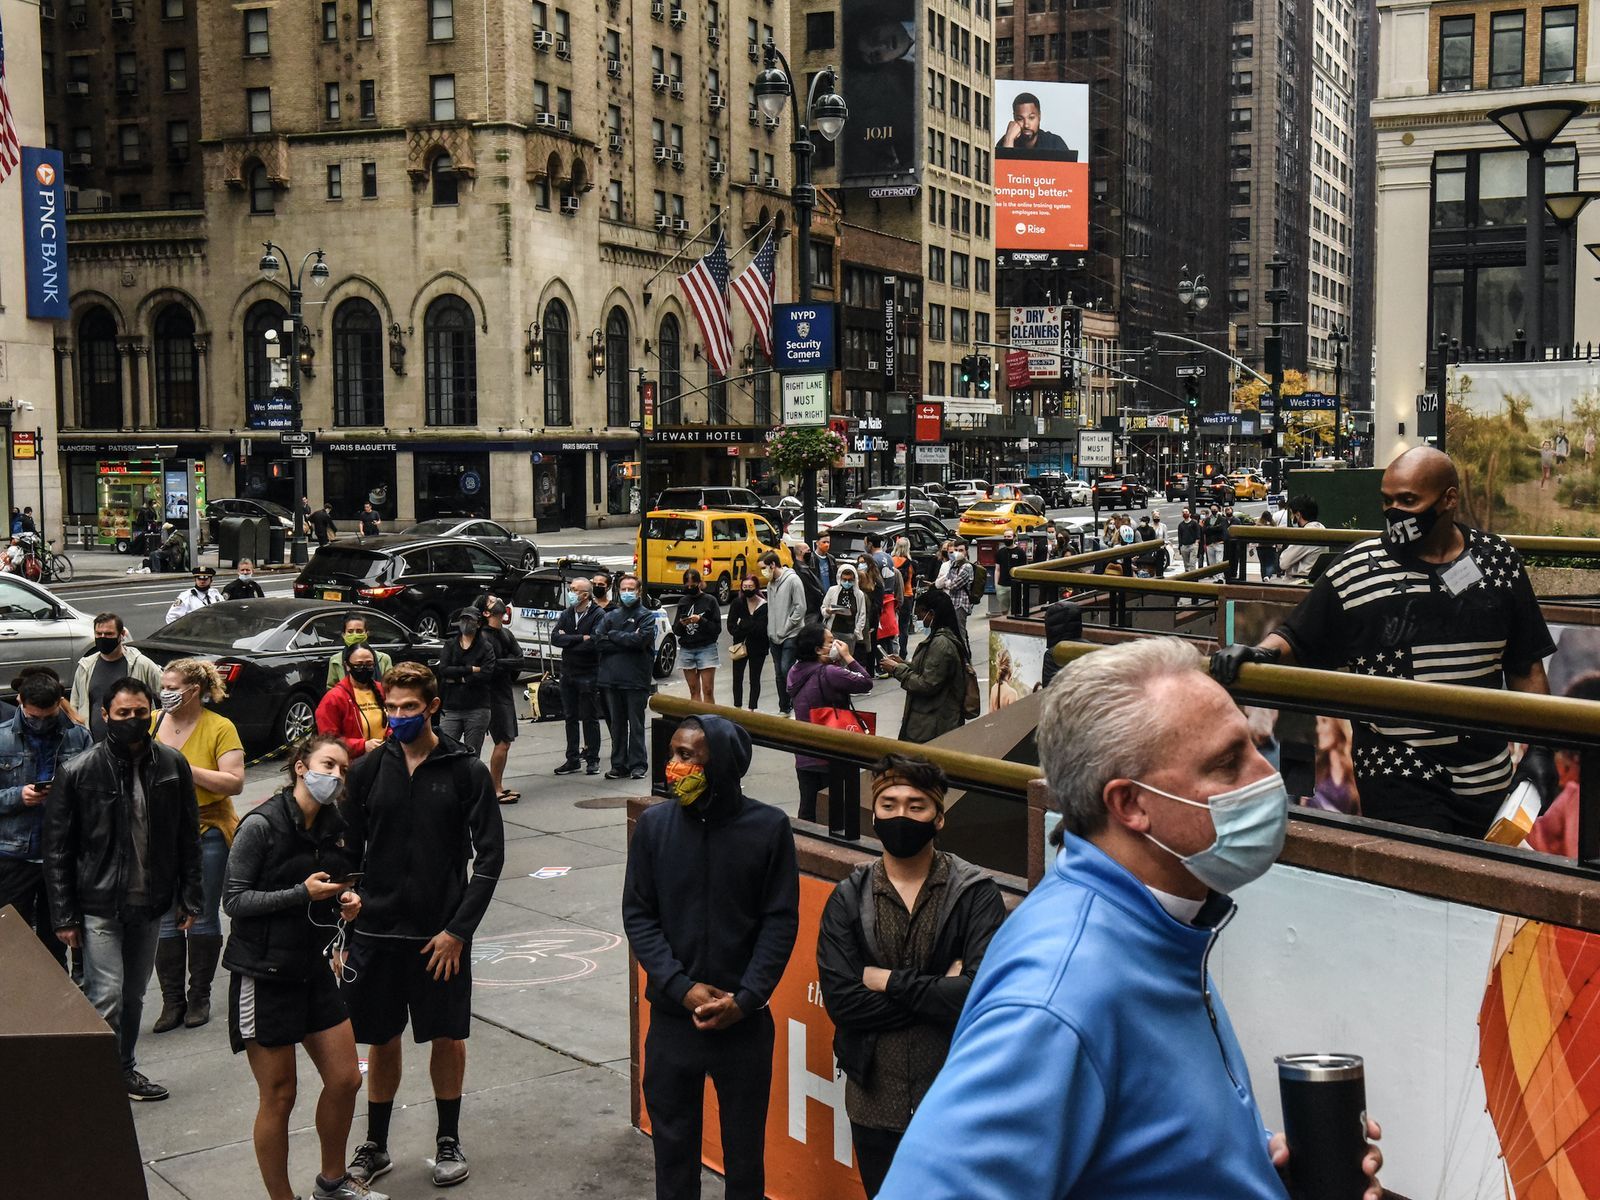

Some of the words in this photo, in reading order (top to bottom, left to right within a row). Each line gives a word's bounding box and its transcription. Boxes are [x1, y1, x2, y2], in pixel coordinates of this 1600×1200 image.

[864, 126, 892, 140] JOJI
[1007, 174, 1031, 184] Train
[1034, 178, 1056, 187] your
[871, 188, 915, 197] OUTFRONT
[39, 189, 56, 240] PNC
[1028, 224, 1046, 234] Rise
[41, 242, 59, 304] BANK
[791, 310, 816, 320] NYPD
[1026, 310, 1044, 324] DRY
[1012, 325, 1059, 339] CLEANERS
[786, 340, 822, 350] Security
[787, 350, 821, 359] Camera
[786, 382, 804, 390] RIGHT
[806, 381, 822, 389] LANE
[794, 395, 814, 406] MUST
[1327, 398, 1336, 407] St
[786, 412, 802, 420] TURN
[805, 411, 823, 419] RIGHT
[868, 417, 882, 429] Nails
[706, 432, 742, 441] HOTEL
[854, 435, 873, 451] FedEx
[873, 436, 889, 451] Office
[1386, 517, 1422, 544] TE
[807, 981, 824, 1008] th
[788, 1017, 853, 1168] H
